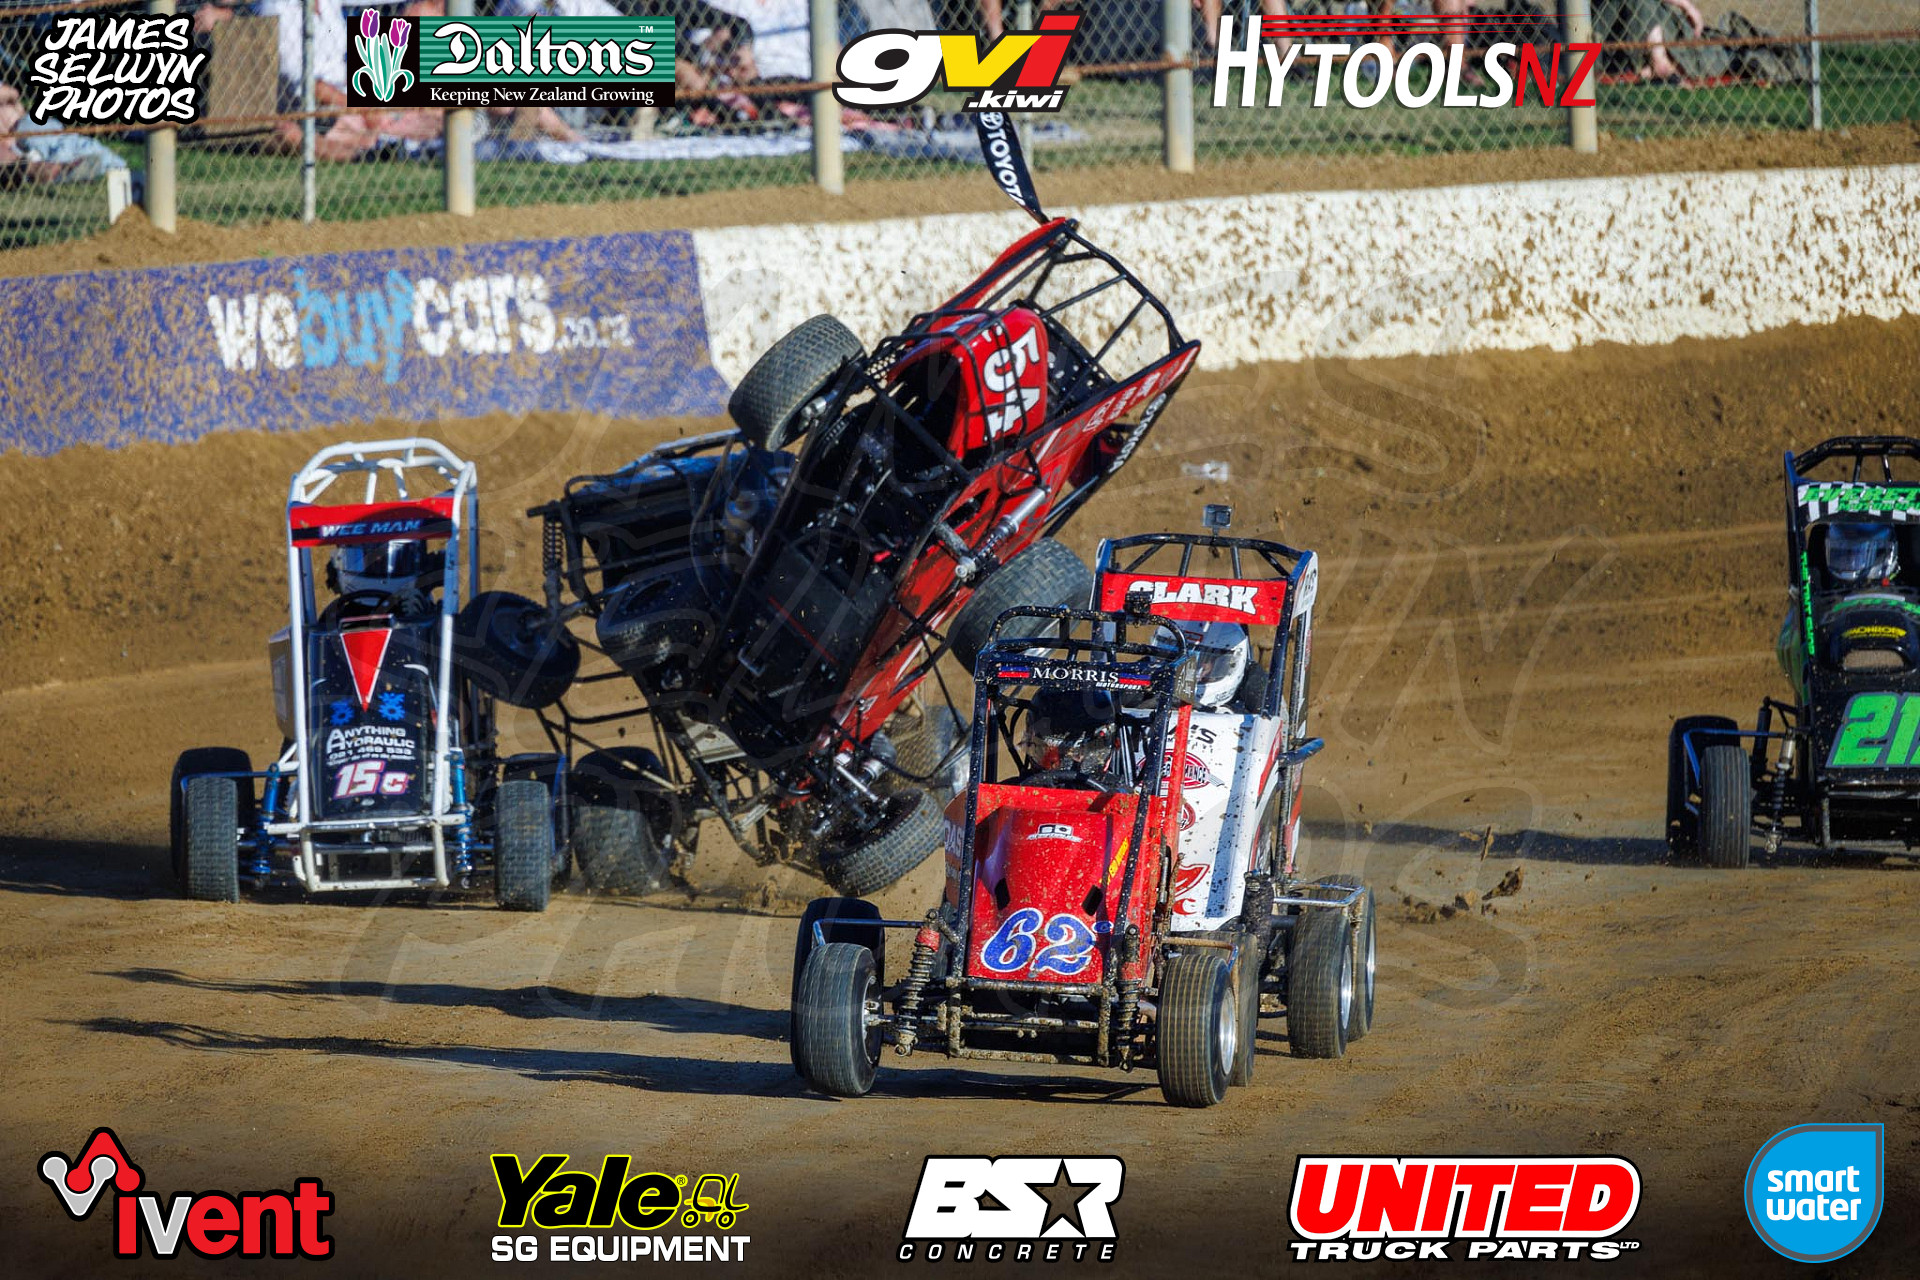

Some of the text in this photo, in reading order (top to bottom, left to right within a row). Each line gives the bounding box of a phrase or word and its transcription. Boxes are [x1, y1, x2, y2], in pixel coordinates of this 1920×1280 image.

[1800, 486, 1920, 502] EVERET
[321, 518, 422, 538] WEE MAN
[1128, 580, 1259, 616] CLARK
[1032, 666, 1120, 683] MORRIS
[327, 724, 407, 746] ANYTHING
[1825, 692, 1920, 768] 21
[980, 907, 1097, 976] 62
